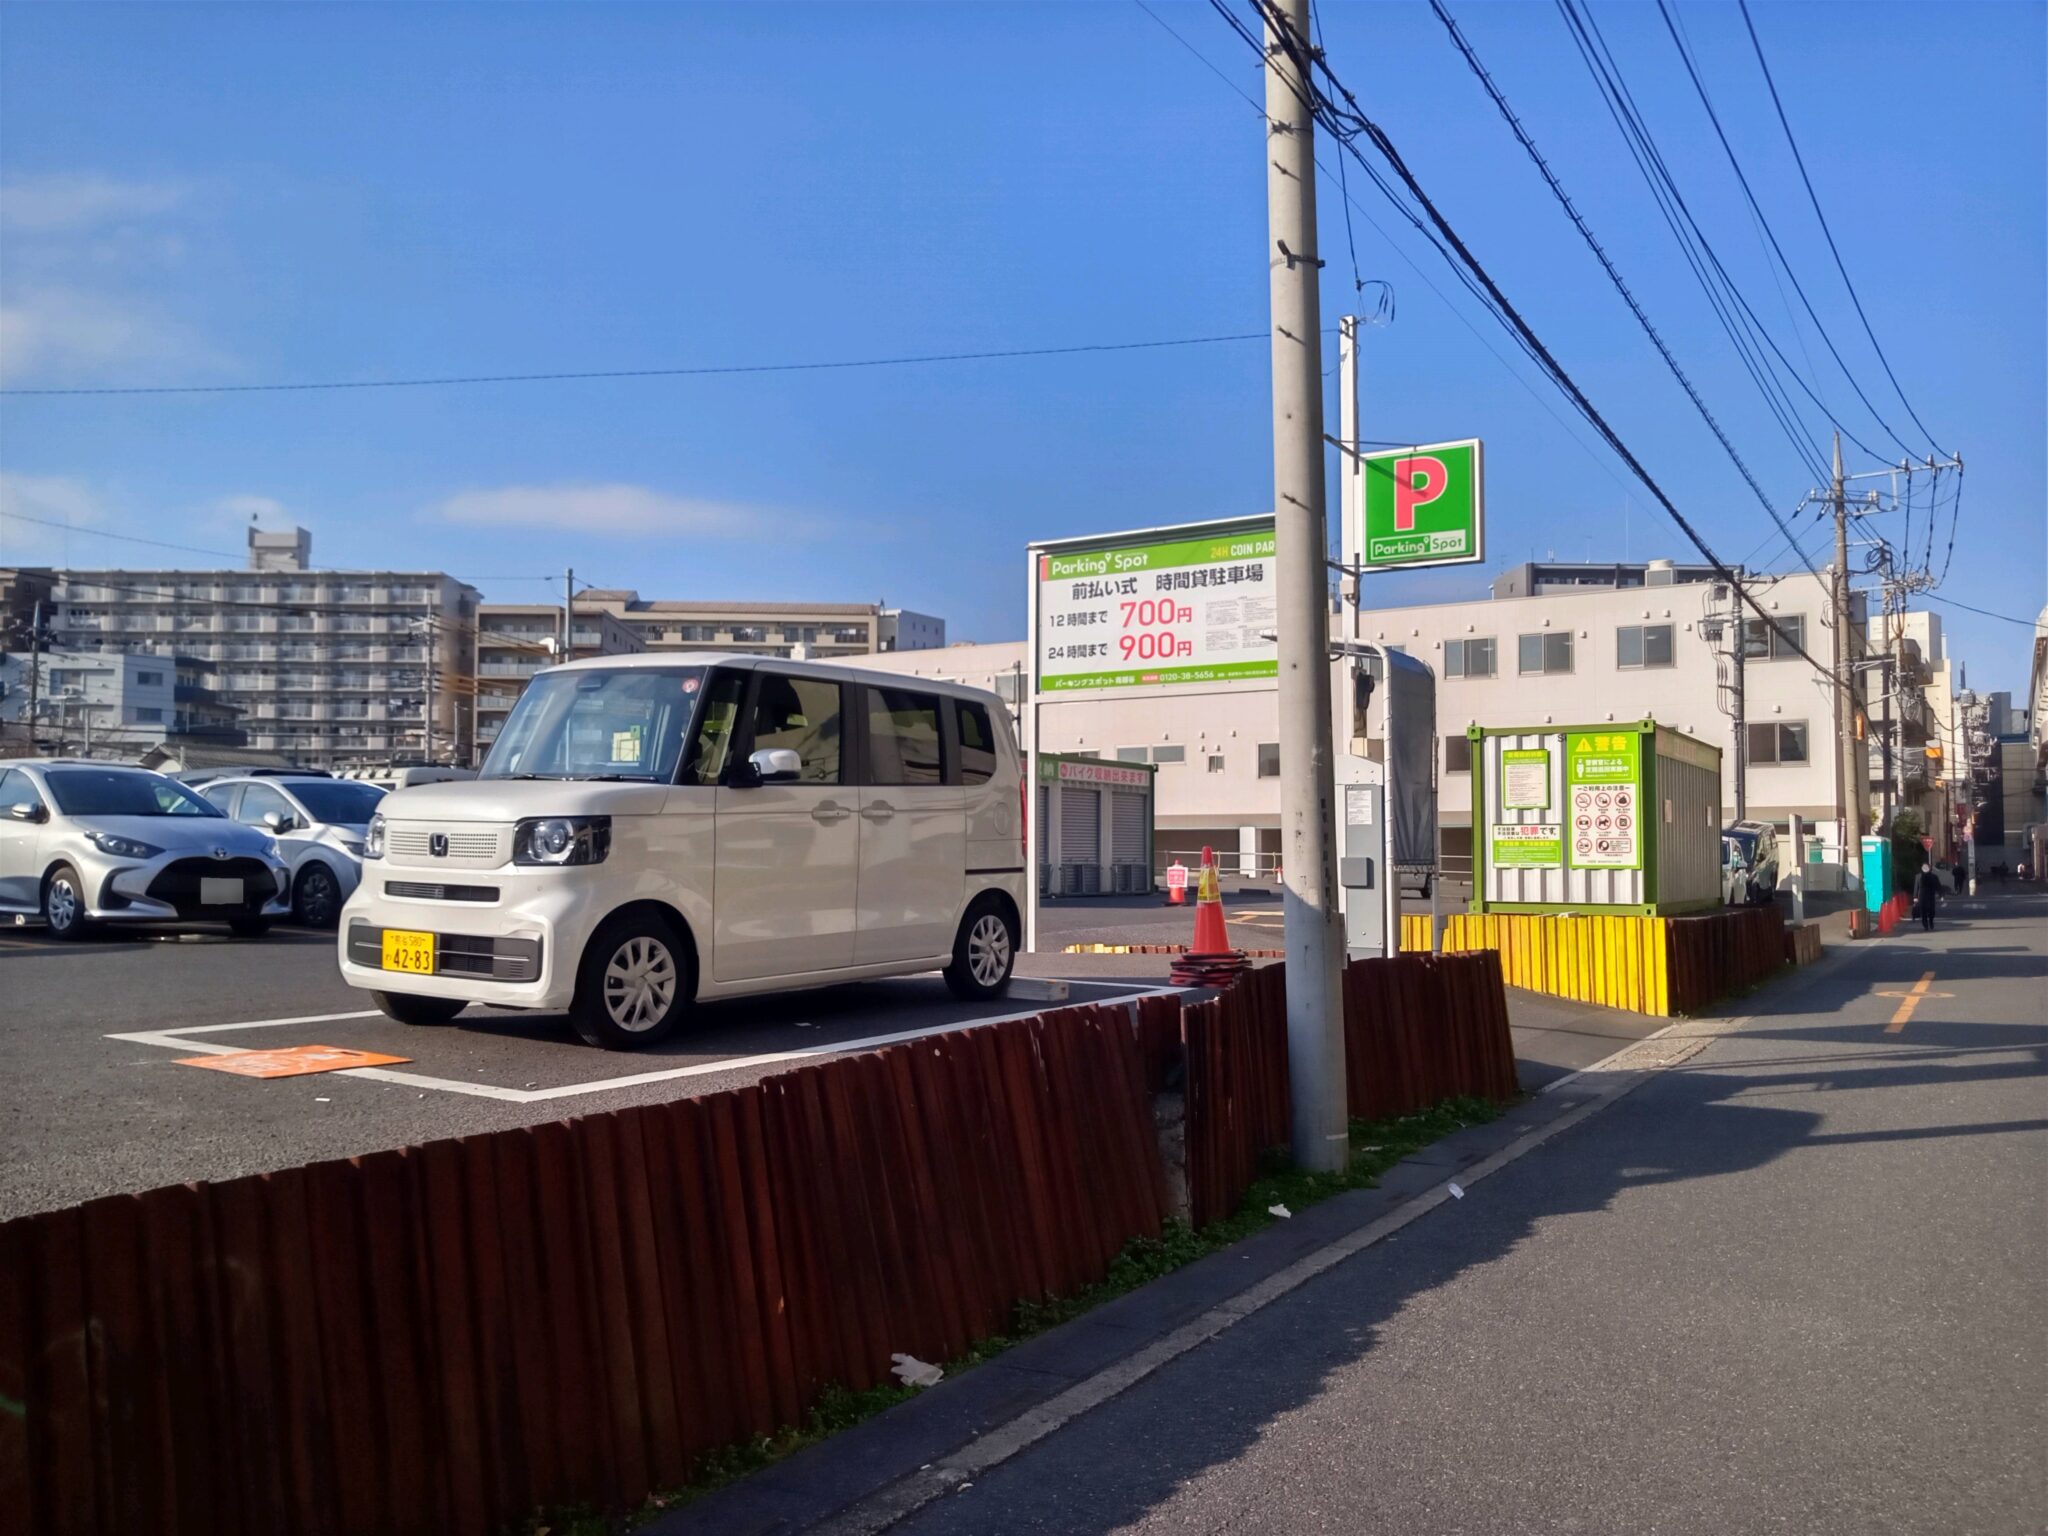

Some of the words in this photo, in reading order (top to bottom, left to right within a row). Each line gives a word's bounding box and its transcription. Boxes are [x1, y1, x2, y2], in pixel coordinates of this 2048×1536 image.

[1394, 456, 1448, 532] P
[1210, 545, 1229, 559] 24H
[1230, 543, 1253, 556] COIN
[1375, 539, 1425, 556] Parking
[1432, 537, 1463, 551] Spot
[1052, 558, 1107, 576] Parking
[1114, 554, 1148, 571] Spot
[1072, 577, 1138, 600] 前払い式
[1155, 564, 1264, 592] 時間貸駐車場
[1159, 670, 1214, 682] 0120-38-5656
[393, 947, 431, 971] 42-83
